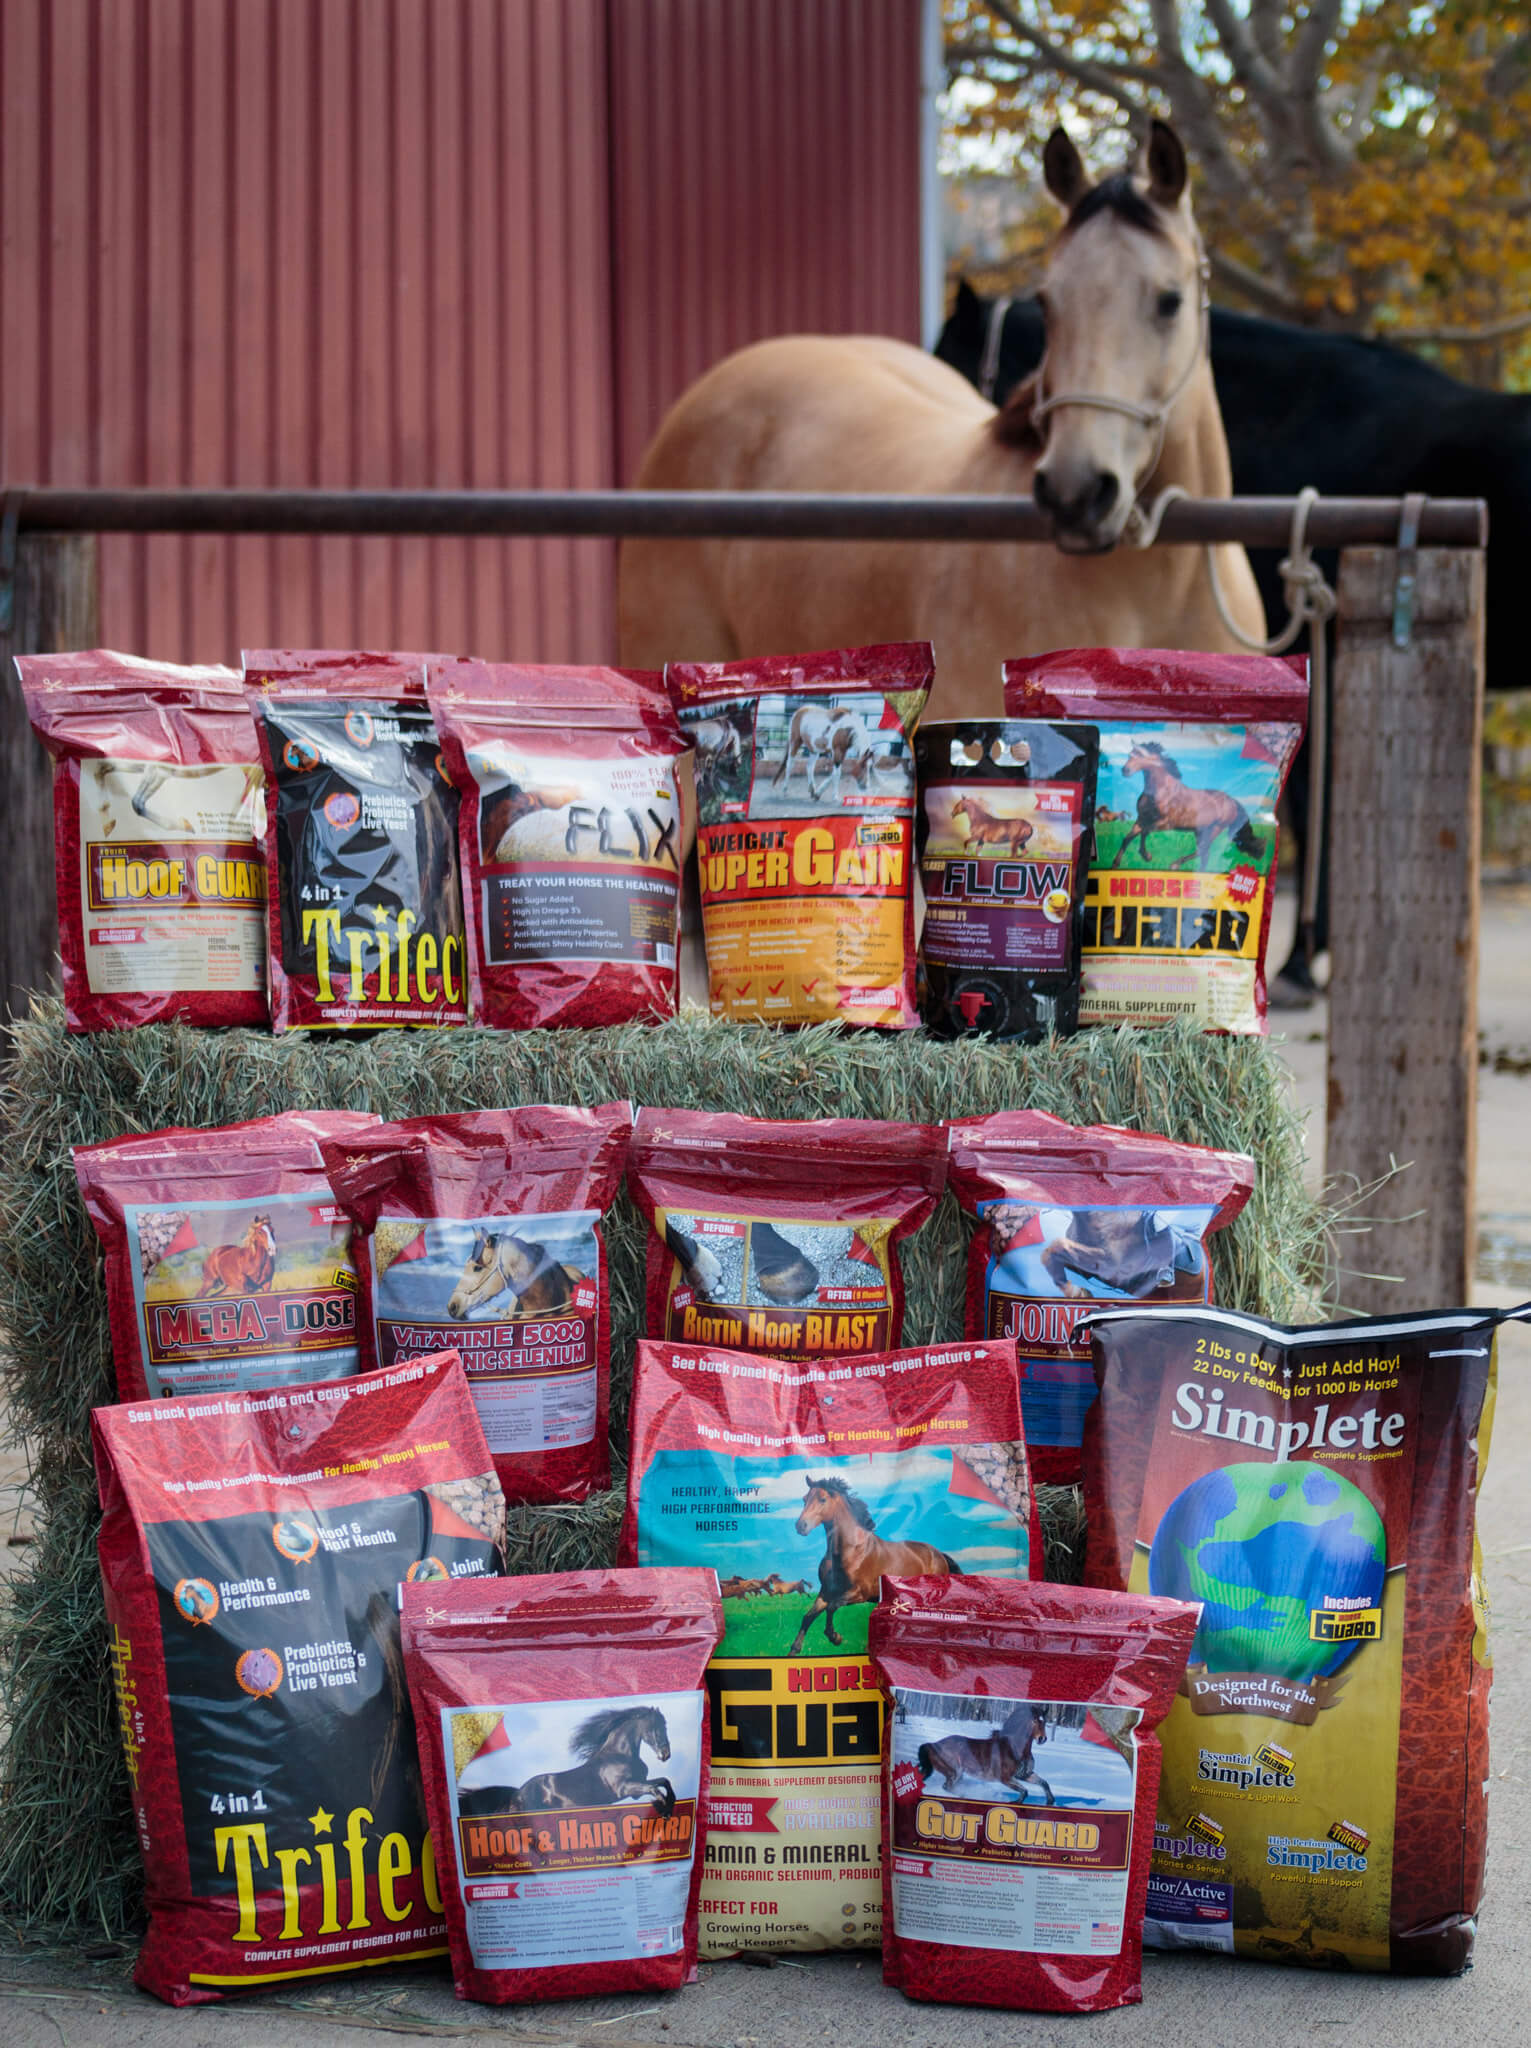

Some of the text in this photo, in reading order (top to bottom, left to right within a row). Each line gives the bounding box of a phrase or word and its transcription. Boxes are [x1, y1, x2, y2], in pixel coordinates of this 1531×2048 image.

[564, 806, 680, 871] FLIX
[709, 831, 788, 853] WEIGHT
[793, 828, 904, 887] GAIN
[101, 857, 186, 899] HOOF
[498, 879, 532, 889] TREAT
[534, 877, 566, 888] YOUR
[568, 878, 603, 889] HORSE
[604, 879, 624, 889] THE
[625, 880, 664, 894] HEALTHY
[943, 861, 1070, 899] FLOW
[1109, 877, 1201, 897] HORSE
[301, 884, 343, 901] 4 in 1
[1126, 1001, 1197, 1014] SUPPLEMENT
[703, 1223, 735, 1234] BEFORE
[827, 1289, 852, 1300] AFTER
[393, 1320, 585, 1349] VITAMIN E 5000
[683, 1306, 878, 1350] BIOTIN HOOF BLAST
[499, 1343, 586, 1368] SELENIUM
[1197, 1339, 1401, 1379] 2 lbs a Day Just Add Hay!
[671, 1350, 972, 1386] See back panel for handle and easy-open feature
[1193, 1360, 1399, 1400] 22 Day Feeding for 1000 lb Horse
[128, 1366, 424, 1424] See back panel for handle and easy-open feature
[698, 1418, 969, 1448] High Quality Ingredients For Healthy, Happy Horses
[1171, 1382, 1406, 1464] Simplete
[163, 1440, 450, 1493] High Quality Complete Supplement For Healthy, Happy Horses
[1313, 1449, 1404, 1463] Complete Supplement
[671, 1485, 760, 1499] HEALTHY, HAPPY
[661, 1502, 771, 1515] HIGH PERFORMANCE
[317, 1522, 361, 1539] Hoof &
[696, 1519, 738, 1531] HORSES
[322, 1529, 397, 1552] Hair Health
[450, 1558, 485, 1577] Joint
[219, 1577, 277, 1597] Health &
[222, 1588, 311, 1612] Performance
[1324, 1595, 1372, 1609] Includes
[284, 1641, 357, 1661] Prebiotics,
[286, 1654, 367, 1677] Probiotics &
[288, 1670, 358, 1692] Live Yeast
[1193, 1679, 1317, 1705] Designed for the
[1219, 1692, 1293, 1714] Northwest
[1199, 1749, 1252, 1766] Essential
[736, 1776, 772, 1787] MINERAL
[773, 1776, 826, 1787] SUPPLEMENT
[828, 1775, 867, 1785] DESIGNED
[1198, 1760, 1296, 1790] Simplete
[210, 1790, 268, 1815] 4 in 1
[785, 1812, 875, 1831] AVAILABLE
[916, 1800, 1100, 1851] GUT GUARD
[468, 1815, 692, 1857] HOOF & HAIR GUARD
[763, 1845, 867, 1864] & MINERAL
[1267, 1847, 1368, 1874] Simplete
[726, 1869, 837, 1883] ORGANIC SELENIUM,
[750, 1901, 779, 1915] FOR
[706, 1922, 809, 1935] Growing Horses
[244, 1928, 428, 1962] COMPLETE SUPPLEMENT DESIGNED FOR ALL
